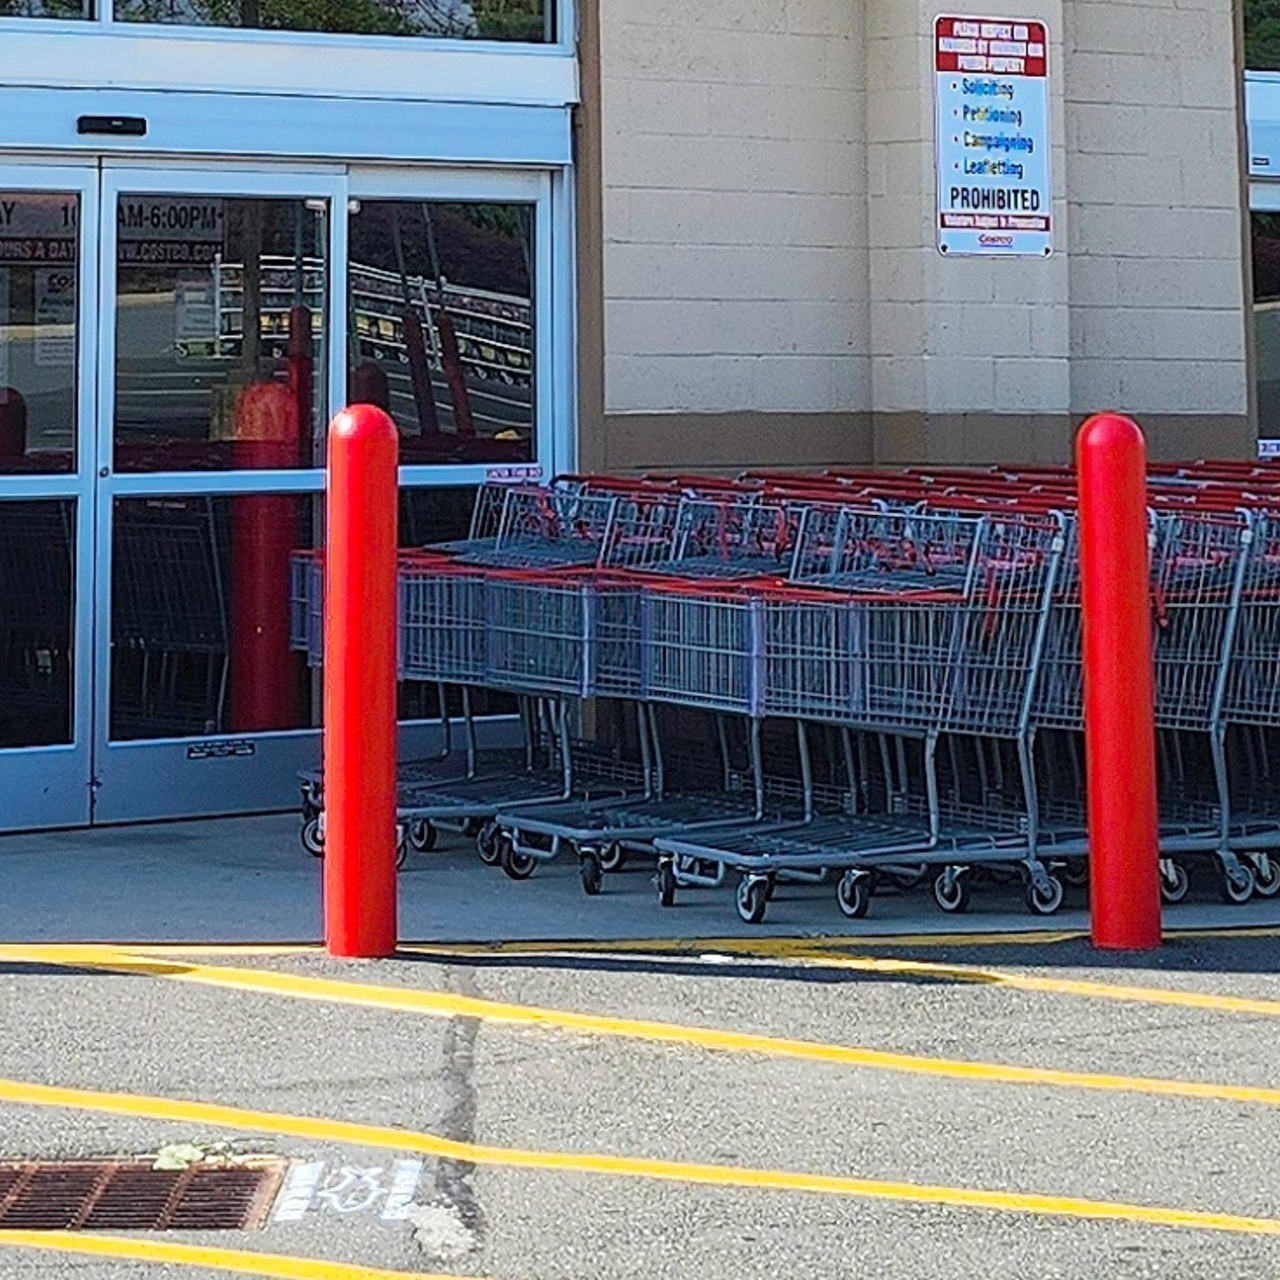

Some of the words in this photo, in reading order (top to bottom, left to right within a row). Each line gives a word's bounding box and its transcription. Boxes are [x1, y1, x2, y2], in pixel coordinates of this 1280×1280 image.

[963, 77, 1014, 100] Soliciting
[963, 105, 1022, 127] Petitioning
[964, 130, 1034, 153] Campaigning
[951, 187, 1040, 211] PROHIBITED
[35, 242, 45, 258] A
